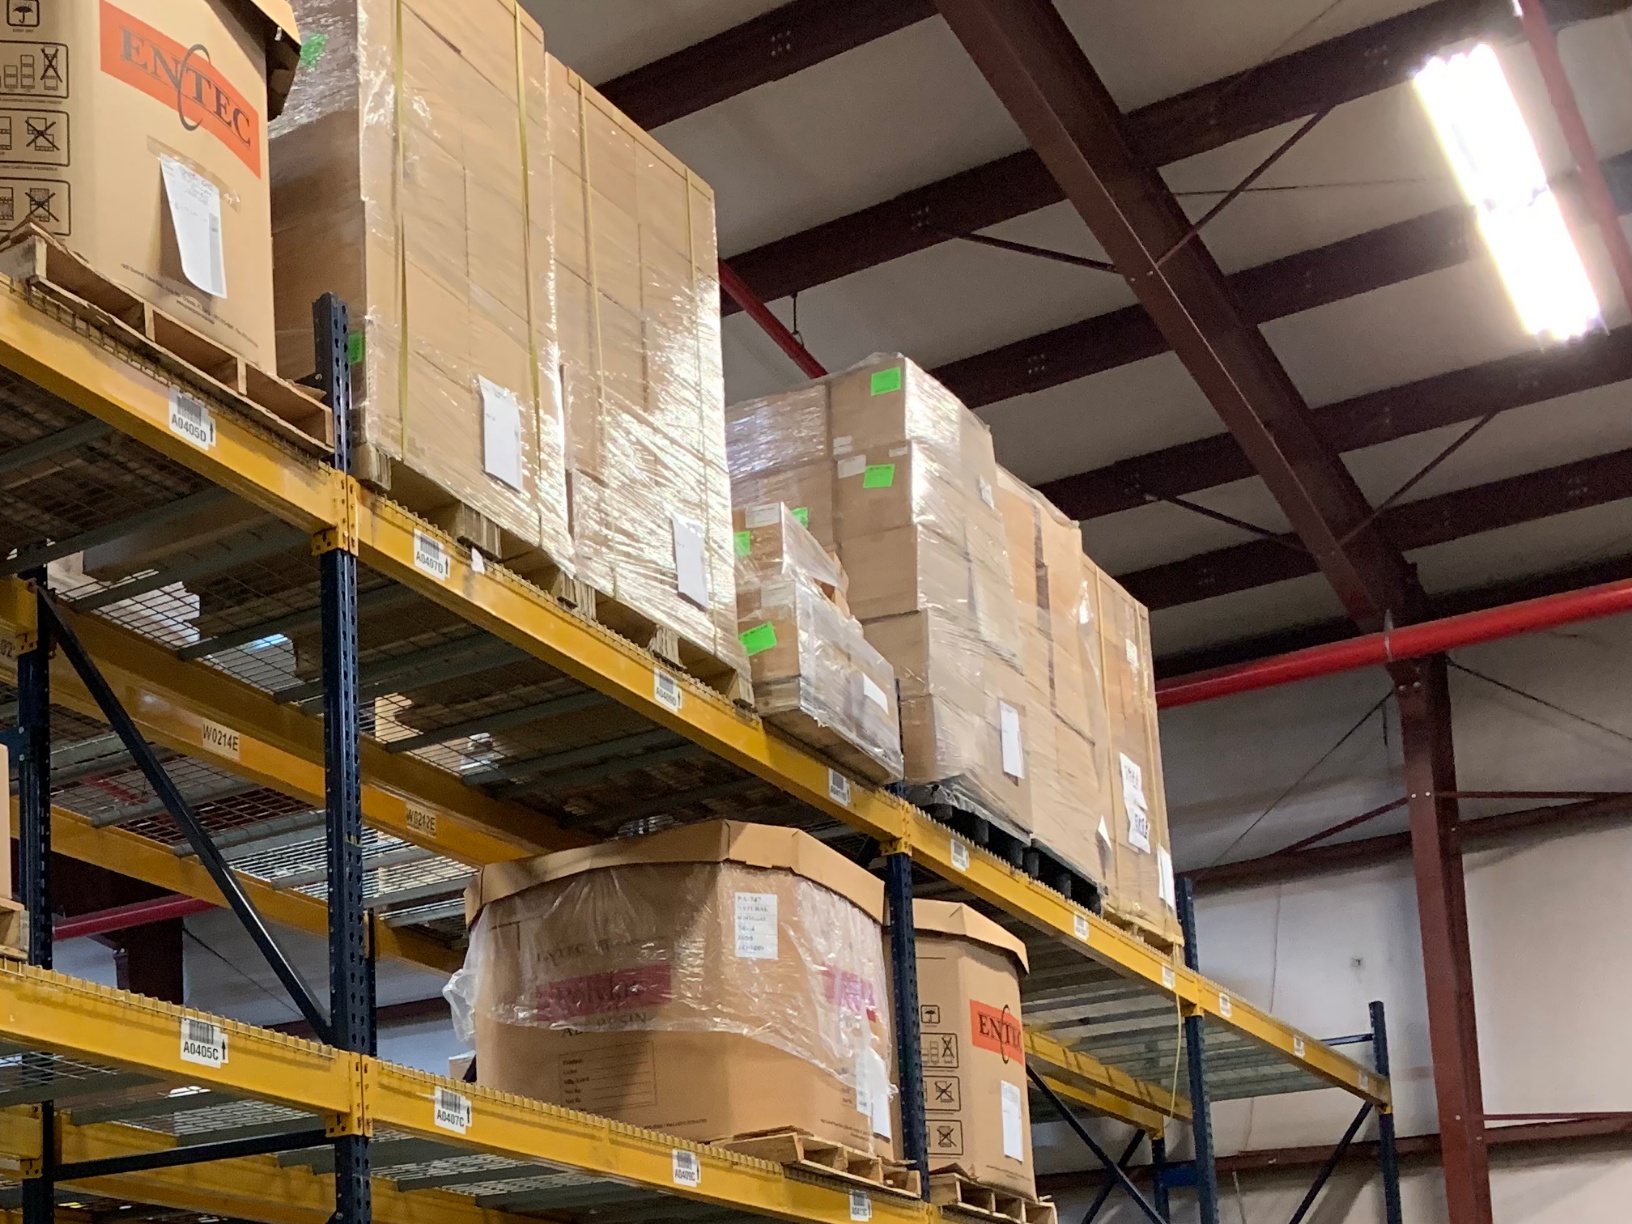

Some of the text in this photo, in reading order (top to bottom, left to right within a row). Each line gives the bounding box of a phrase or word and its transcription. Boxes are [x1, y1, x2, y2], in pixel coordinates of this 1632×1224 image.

[119, 28, 252, 148] ENTEC
[171, 413, 207, 443] A0405D
[415, 551, 444, 574] A0407D
[202, 724, 239, 752] W0214E
[183, 1041, 219, 1061] A0405C
[436, 1109, 465, 1129] A0407C
[674, 1168, 696, 1182] A0409C
